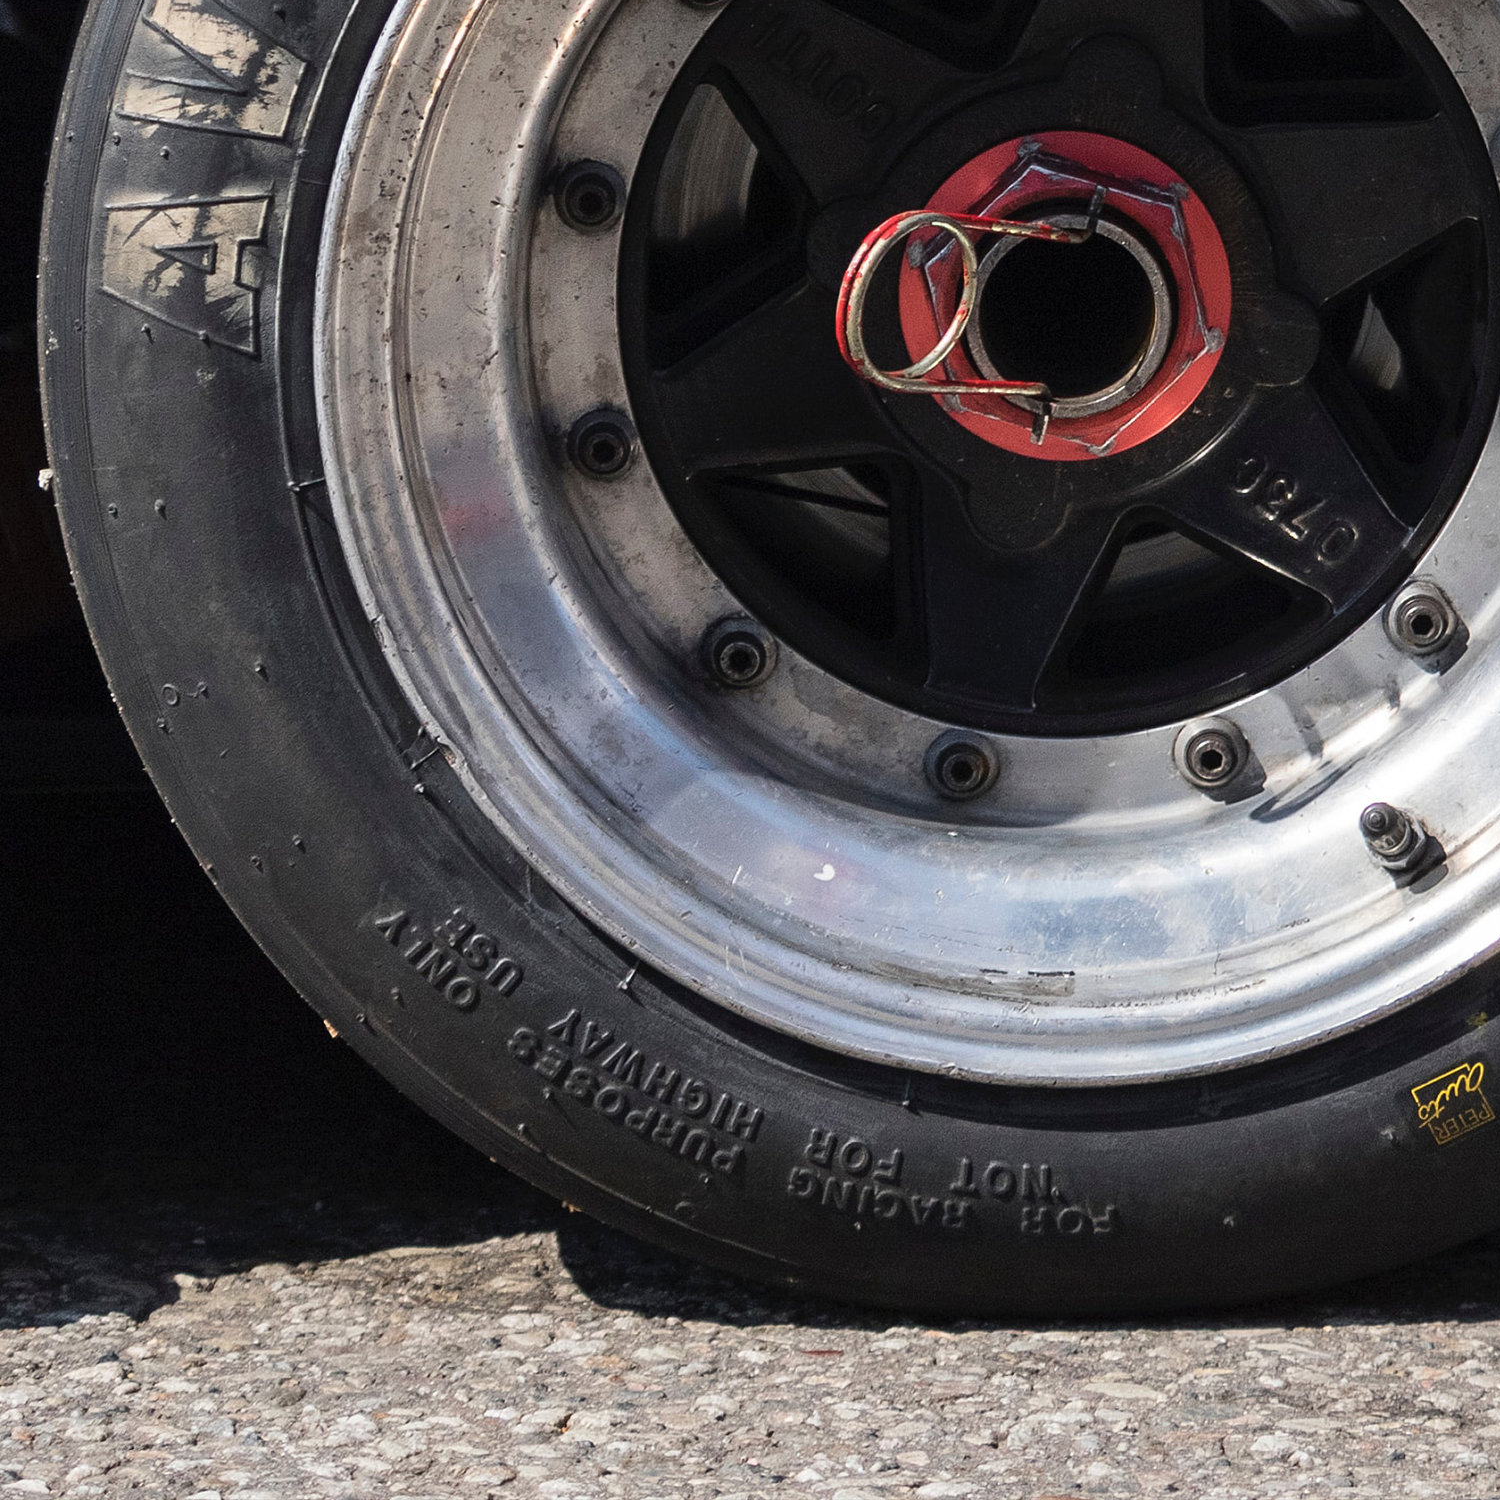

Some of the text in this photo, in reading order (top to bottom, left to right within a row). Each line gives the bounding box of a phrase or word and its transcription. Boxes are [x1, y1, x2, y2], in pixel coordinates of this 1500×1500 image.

[434, 907, 1065, 1205] NOT FOR HIGHWAY USE
[1417, 1061, 1485, 1128] auto
[1434, 1107, 1492, 1142] PETER
[787, 1165, 980, 1231] RACING
[1020, 1204, 1122, 1236] FOR
